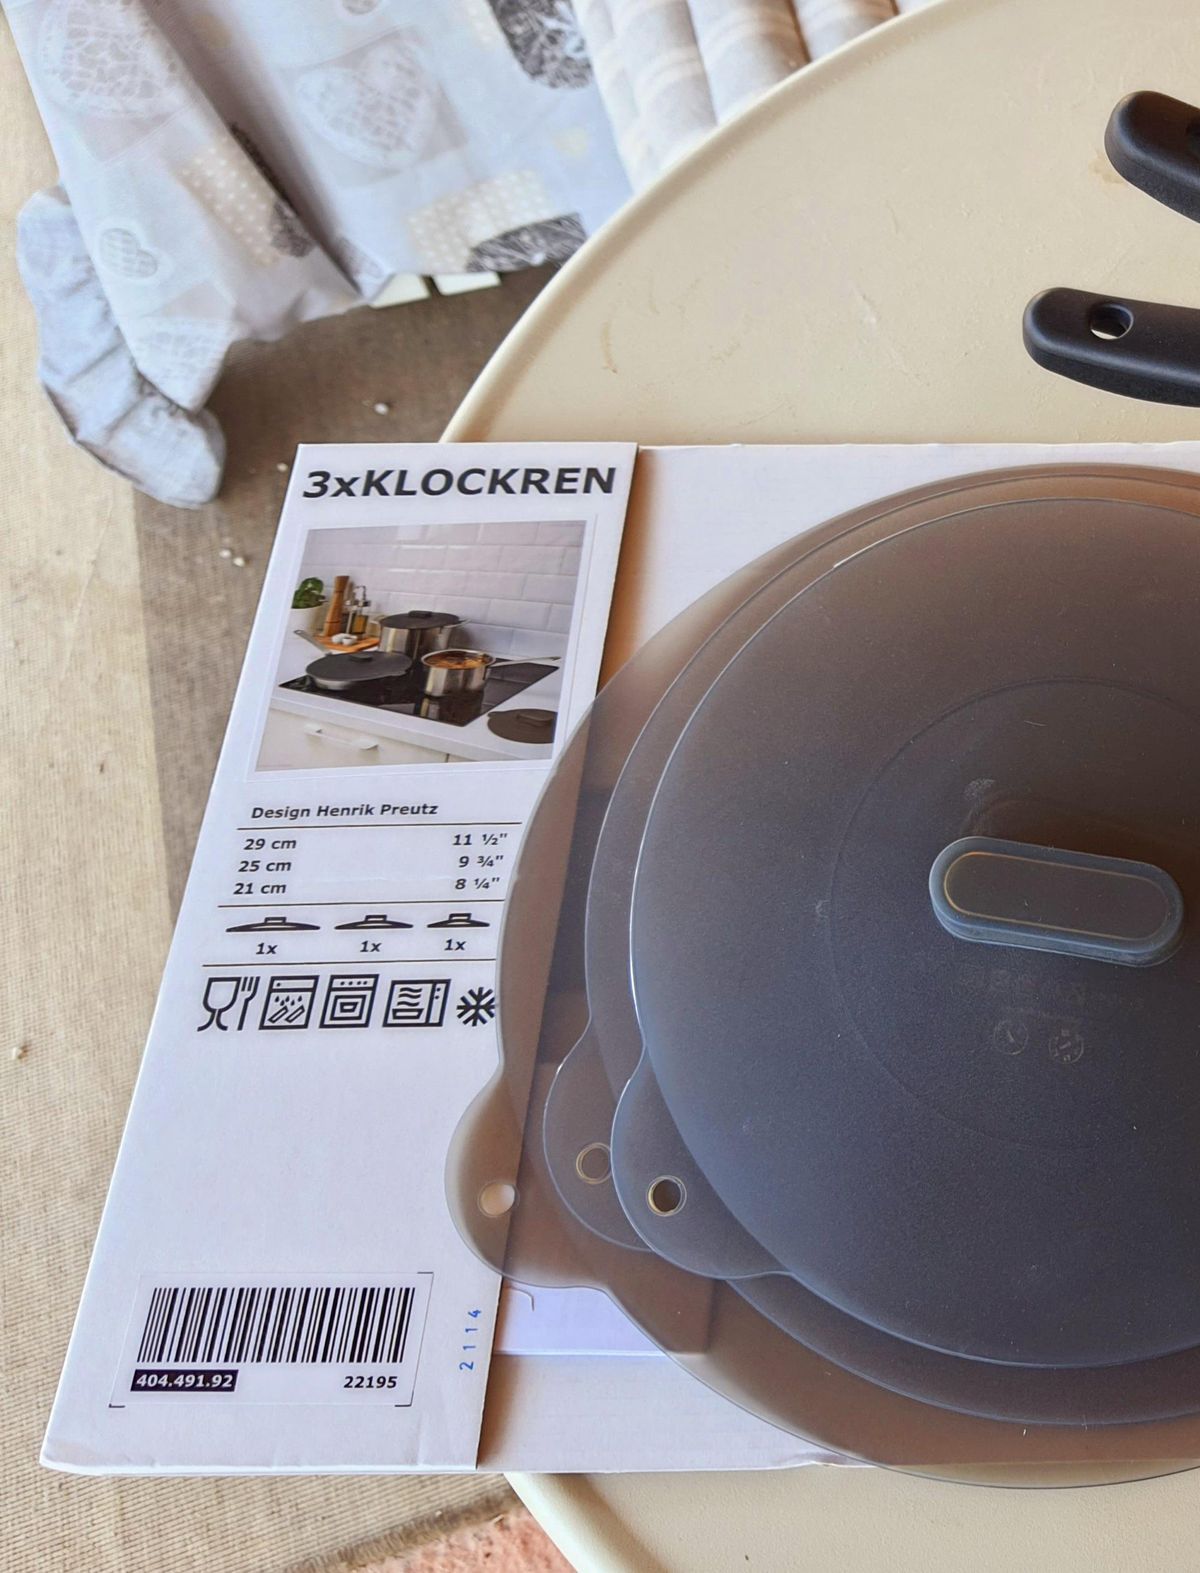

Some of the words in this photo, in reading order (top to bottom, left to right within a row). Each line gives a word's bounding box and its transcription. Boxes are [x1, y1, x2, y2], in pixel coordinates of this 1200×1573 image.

[302, 467, 617, 499] 3xKLOCKREN
[251, 805, 311, 821] Design
[316, 804, 374, 818] Henrik
[380, 803, 439, 816] Preutz
[243, 838, 266, 850] 29
[271, 839, 297, 849] cm
[452, 834, 472, 846] 11
[237, 860, 260, 872] 25
[266, 862, 292, 872] cm
[458, 856, 469, 868] 9
[233, 883, 254, 895] 21
[260, 884, 286, 894] cm
[455, 878, 466, 890] 8
[255, 943, 278, 955] 1x
[360, 941, 382, 953] 1x
[444, 939, 467, 951] 1x
[135, 1373, 234, 1389] 404.491.92
[343, 1375, 398, 1389] 22195
